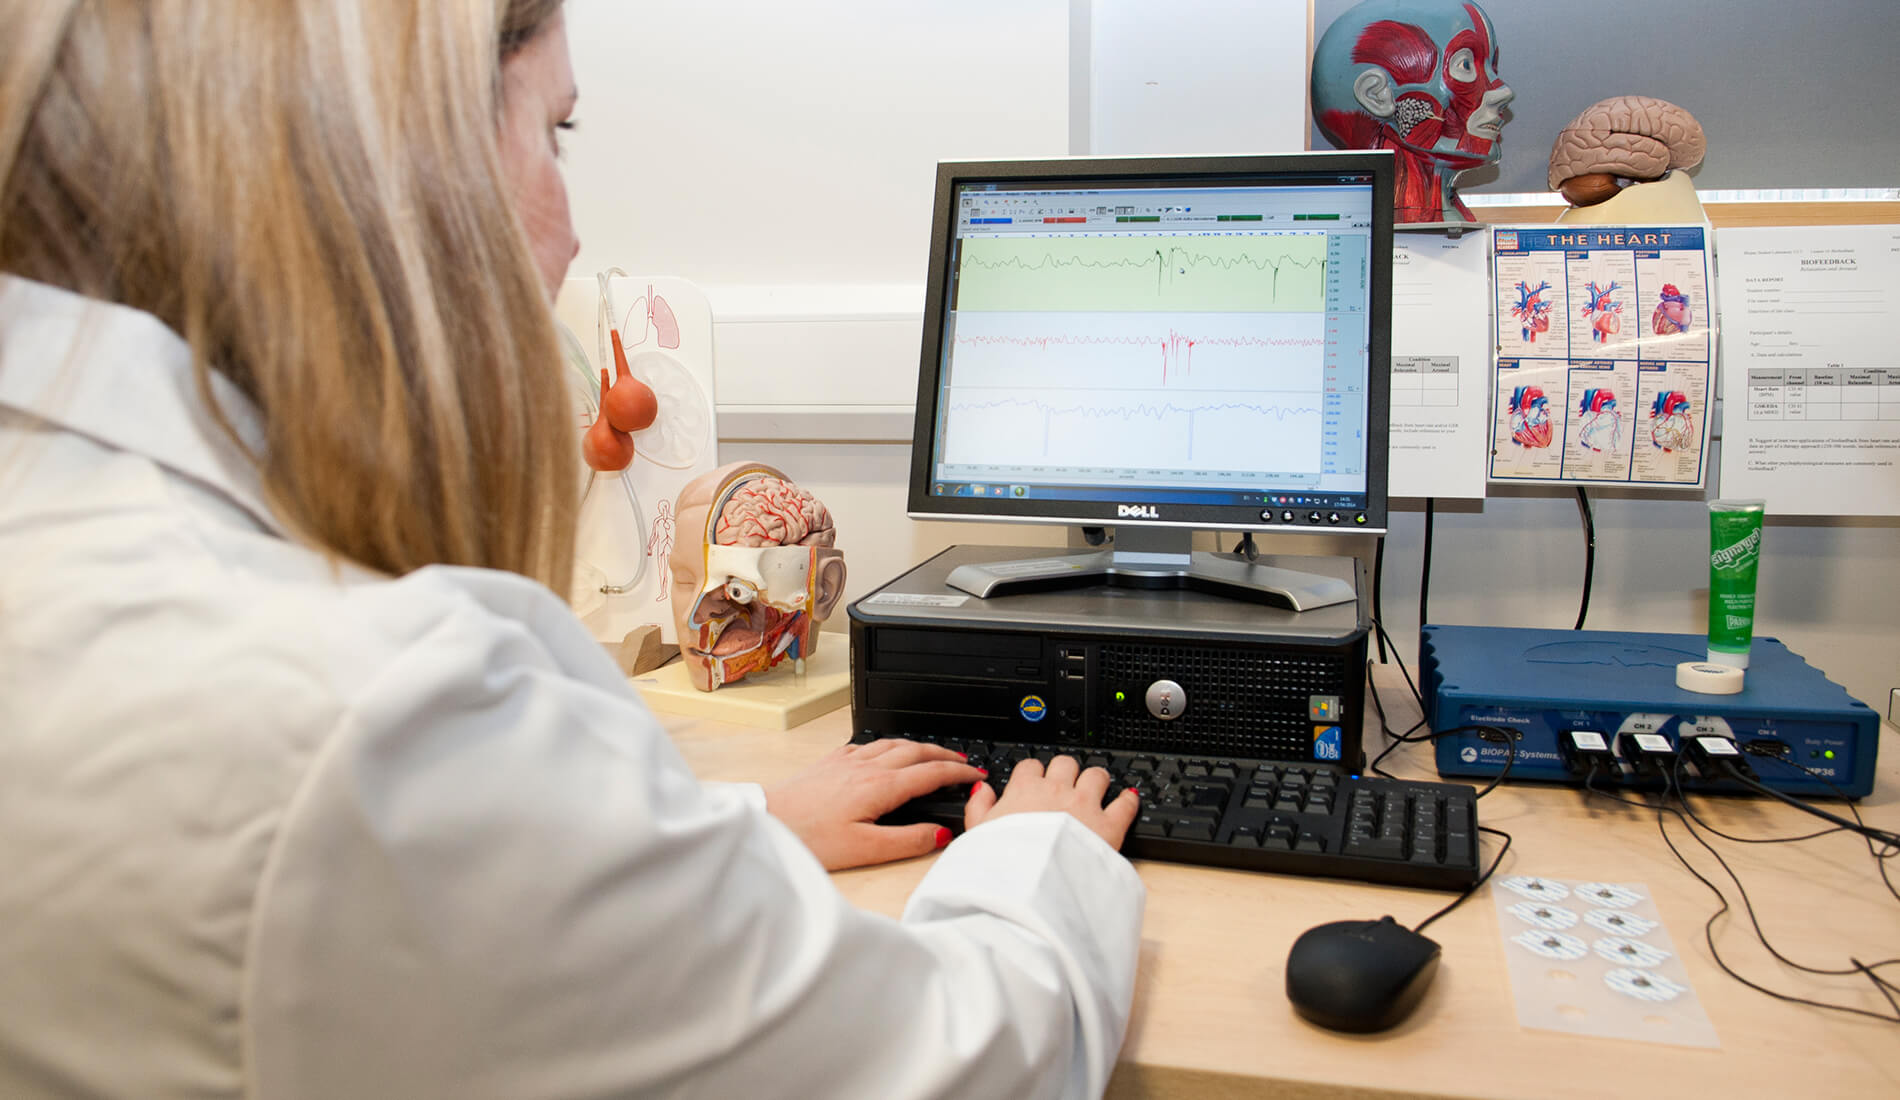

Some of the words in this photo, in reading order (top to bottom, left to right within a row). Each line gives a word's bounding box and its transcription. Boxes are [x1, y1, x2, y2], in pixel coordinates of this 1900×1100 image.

[1546, 234, 1588, 246] THE
[1597, 232, 1673, 246] HEART
[1800, 258, 1857, 266] BIOFEEDBACK
[1117, 504, 1159, 518] DELL
[1470, 714, 1506, 723] Electrode
[1507, 716, 1531, 725] Check
[1480, 747, 1518, 758] BIOPA
